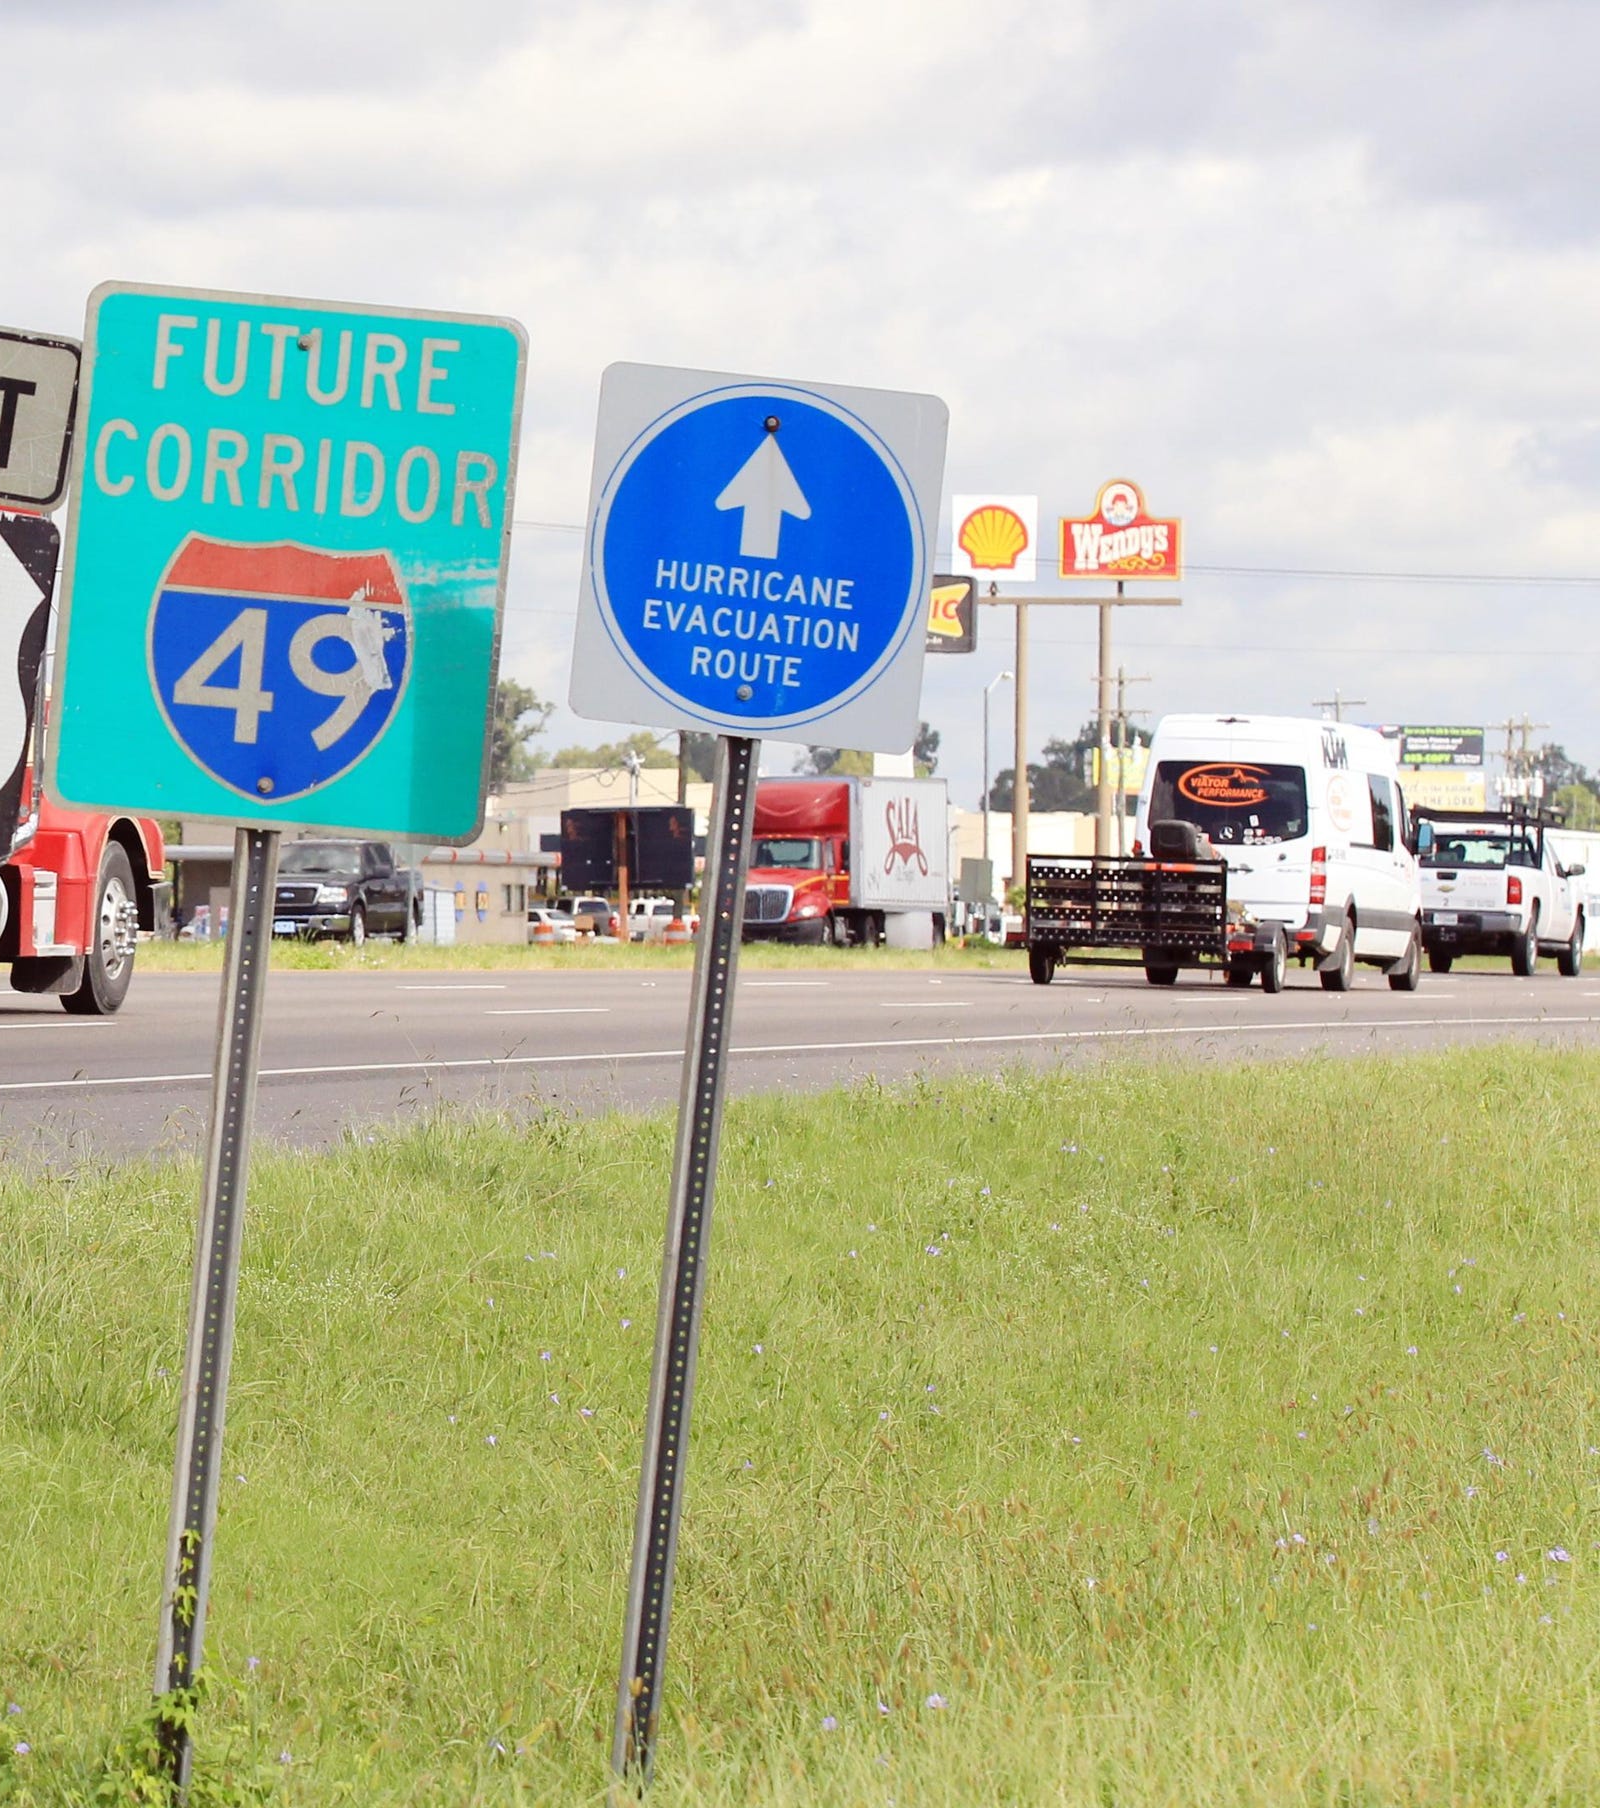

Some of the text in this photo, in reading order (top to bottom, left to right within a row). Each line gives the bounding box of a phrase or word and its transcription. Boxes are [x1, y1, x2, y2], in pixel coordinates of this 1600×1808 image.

[152, 314, 460, 416] FUTURE
[94, 418, 497, 528] CORRIDOR
[655, 559, 855, 610] HURRICANE
[643, 599, 860, 652] EVACUATION
[173, 607, 380, 752] 49
[690, 646, 802, 688] ROUTE
[1191, 776, 1229, 788] VIATOR
[1198, 787, 1265, 799] PERFORMANCE
